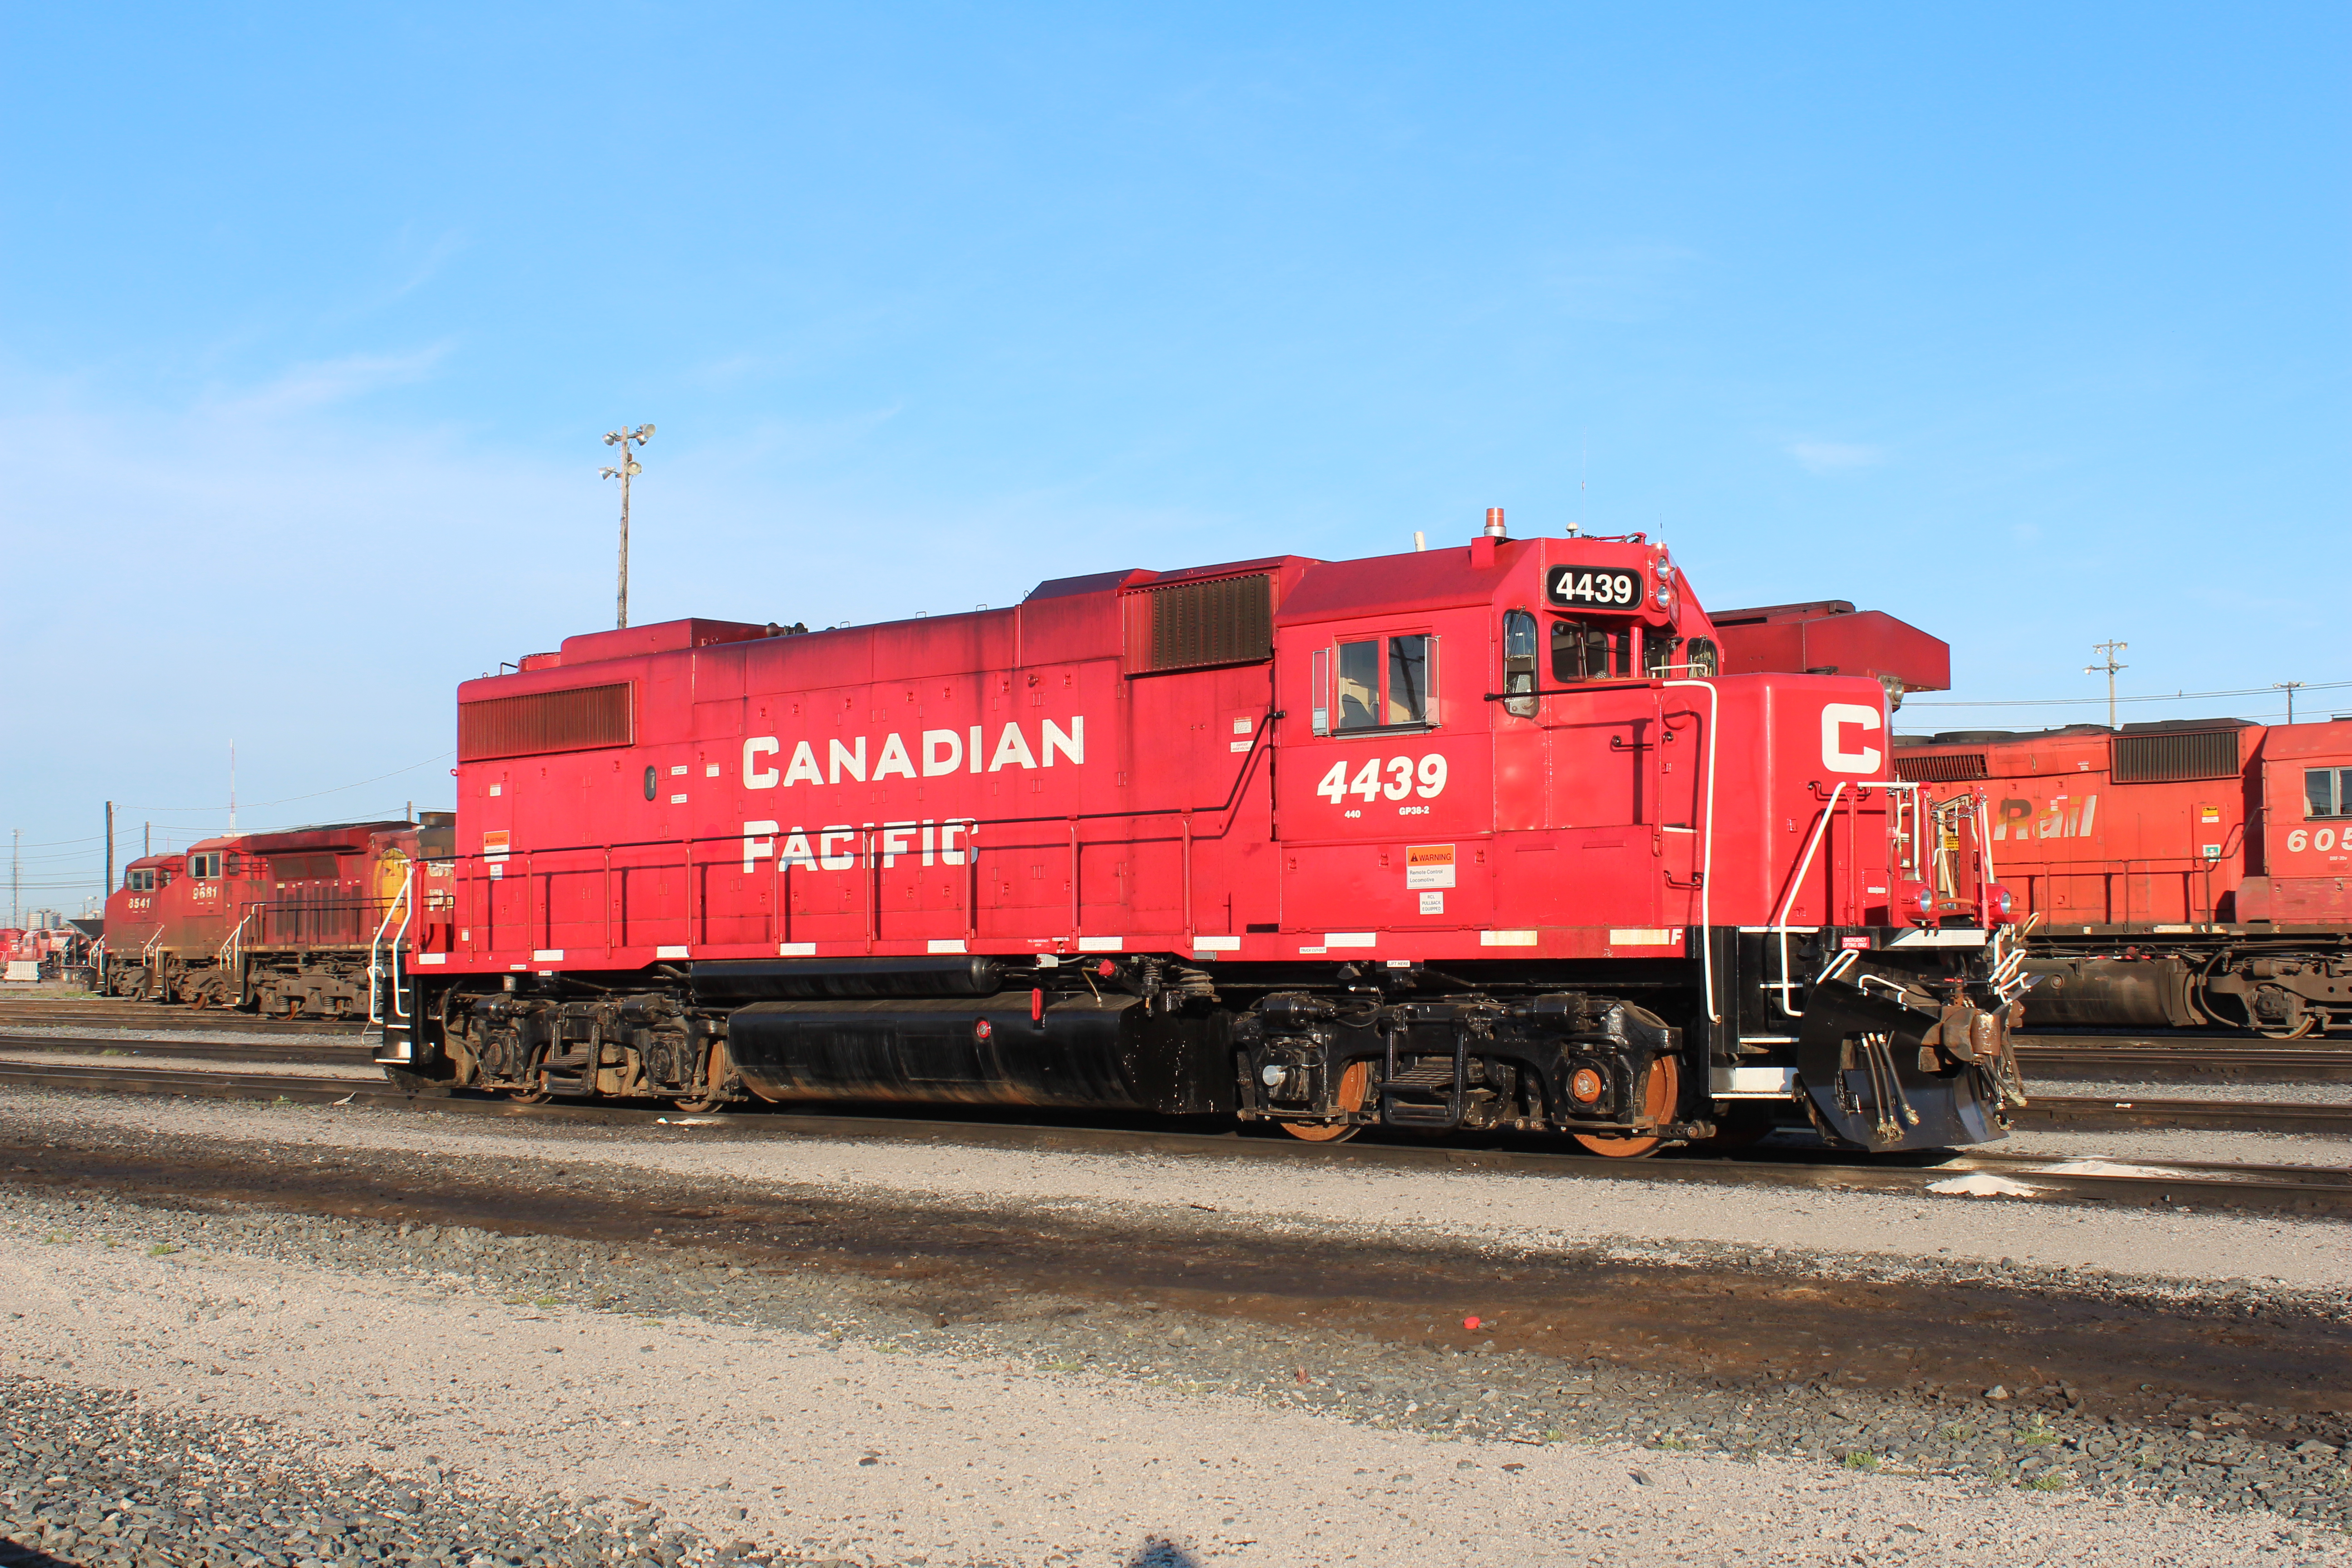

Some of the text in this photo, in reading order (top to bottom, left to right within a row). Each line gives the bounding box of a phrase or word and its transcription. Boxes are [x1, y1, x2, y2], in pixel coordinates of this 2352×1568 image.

[1556, 572, 1632, 604] 4439
[743, 715, 1084, 789] CANADIAN
[1821, 703, 1881, 774] C
[1317, 753, 1448, 804] 4439
[1344, 810, 1361, 818] 440
[1399, 805, 1430, 815] GP38-2
[1993, 795, 2097, 840] Rail
[743, 818, 979, 874] PACIFIC
[128, 897, 151, 909] 8541
[192, 886, 217, 900] 9681
[1671, 929, 1683, 945] F
